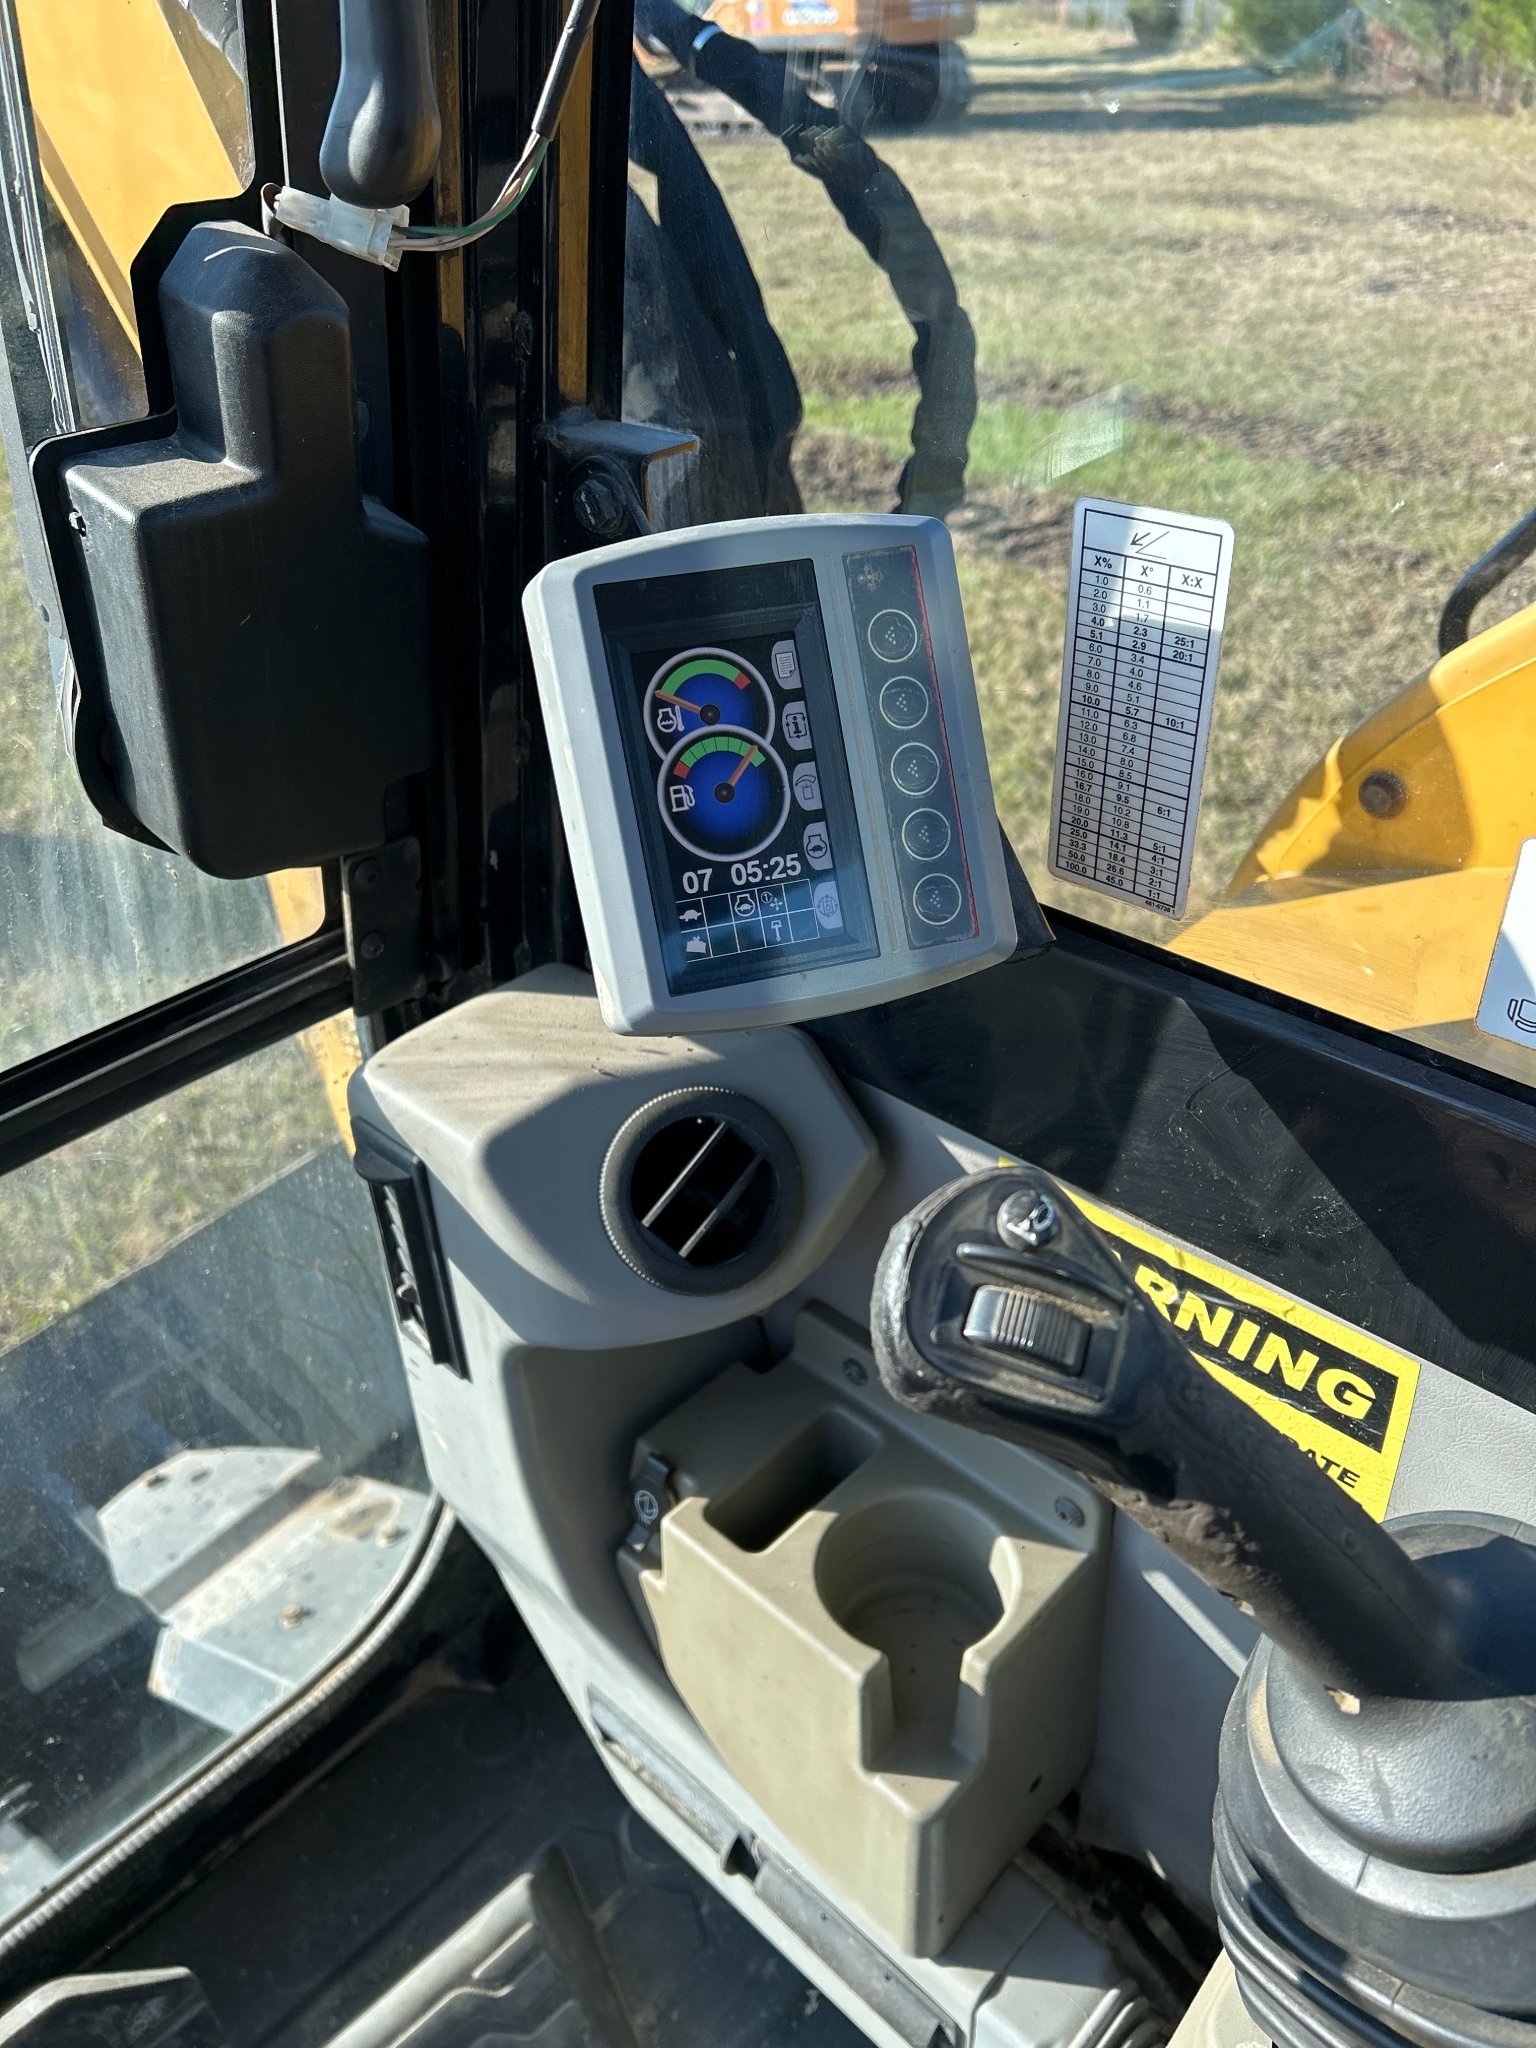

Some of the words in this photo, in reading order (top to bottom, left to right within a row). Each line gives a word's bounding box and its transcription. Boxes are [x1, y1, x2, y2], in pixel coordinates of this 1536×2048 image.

[1094, 555, 1112, 569] X%
[1182, 574, 1203, 588] X:X
[1096, 575, 1108, 586] 1.0
[1138, 584, 1152, 595] 0.6
[1094, 589, 1108, 599] 2.0
[1138, 599, 1150, 609] 1.1
[1093, 603, 1106, 613] 3.0
[1136, 613, 1149, 623] 1.7
[1091, 616, 1105, 627] 4.0
[1134, 626, 1148, 637] 2.3
[1175, 636, 1195, 648] 25:1
[1088, 643, 1102, 654] 6.0
[1131, 654, 1144, 664] 3.4
[1090, 630, 1103, 640] 5.1
[1132, 640, 1146, 651] 2.9
[1173, 650, 1193, 662] 20:1
[1088, 656, 1101, 666] 7.0
[1129, 667, 1144, 678] 4.0
[1086, 669, 1100, 680] 8.0
[1128, 680, 1142, 691] 4.6
[1085, 682, 1099, 693] 9.0
[1127, 694, 1140, 704] 5.1
[1081, 708, 1099, 719] 11.0
[1124, 720, 1138, 730] 6.3
[1082, 694, 1100, 706] 10.0
[1125, 706, 1139, 716] 5.7
[1166, 717, 1184, 729] 10:1
[1080, 720, 1098, 732] 12.0
[1123, 732, 1136, 742] 6.8
[1079, 733, 1096, 744] 13.0
[1121, 745, 1135, 755] 7.4
[1078, 745, 1096, 756] 14.0
[1120, 758, 1134, 768] 8.0
[1076, 769, 1093, 780] 16.0
[1117, 782, 1130, 791] 9.1
[1077, 757, 1094, 768] 15.0
[1119, 770, 1132, 780] 8.5
[1074, 781, 1092, 792] 16.7
[1116, 794, 1130, 804] 9.5
[1157, 807, 1171, 817] 6:1
[1074, 793, 1091, 804] 18.0
[1113, 805, 1130, 816] 10.2
[1073, 805, 1090, 816] 19.0
[1112, 817, 1130, 829] 10.8
[1071, 816, 1089, 828] 20.0
[1110, 829, 1128, 840] 11.3
[1153, 843, 1166, 853] 5:1
[1069, 839, 1086, 851] 33.3
[1108, 852, 1126, 863] 18.4
[1150, 866, 1163, 877] 3:1
[1070, 828, 1088, 839] 25.0
[1109, 841, 1126, 852] 14.1
[1152, 855, 1165, 865] 4:1
[682, 868, 712, 894] 07
[731, 853, 801, 886] 05:25
[1065, 861, 1087, 874] 100.0
[1106, 875, 1123, 887] 45.0
[1148, 889, 1160, 899] 1:1
[1068, 850, 1086, 862] 50.0
[1107, 864, 1124, 876] 26.6
[1149, 878, 1162, 888] 2:1
[1112, 1249, 1377, 1419] RNING
